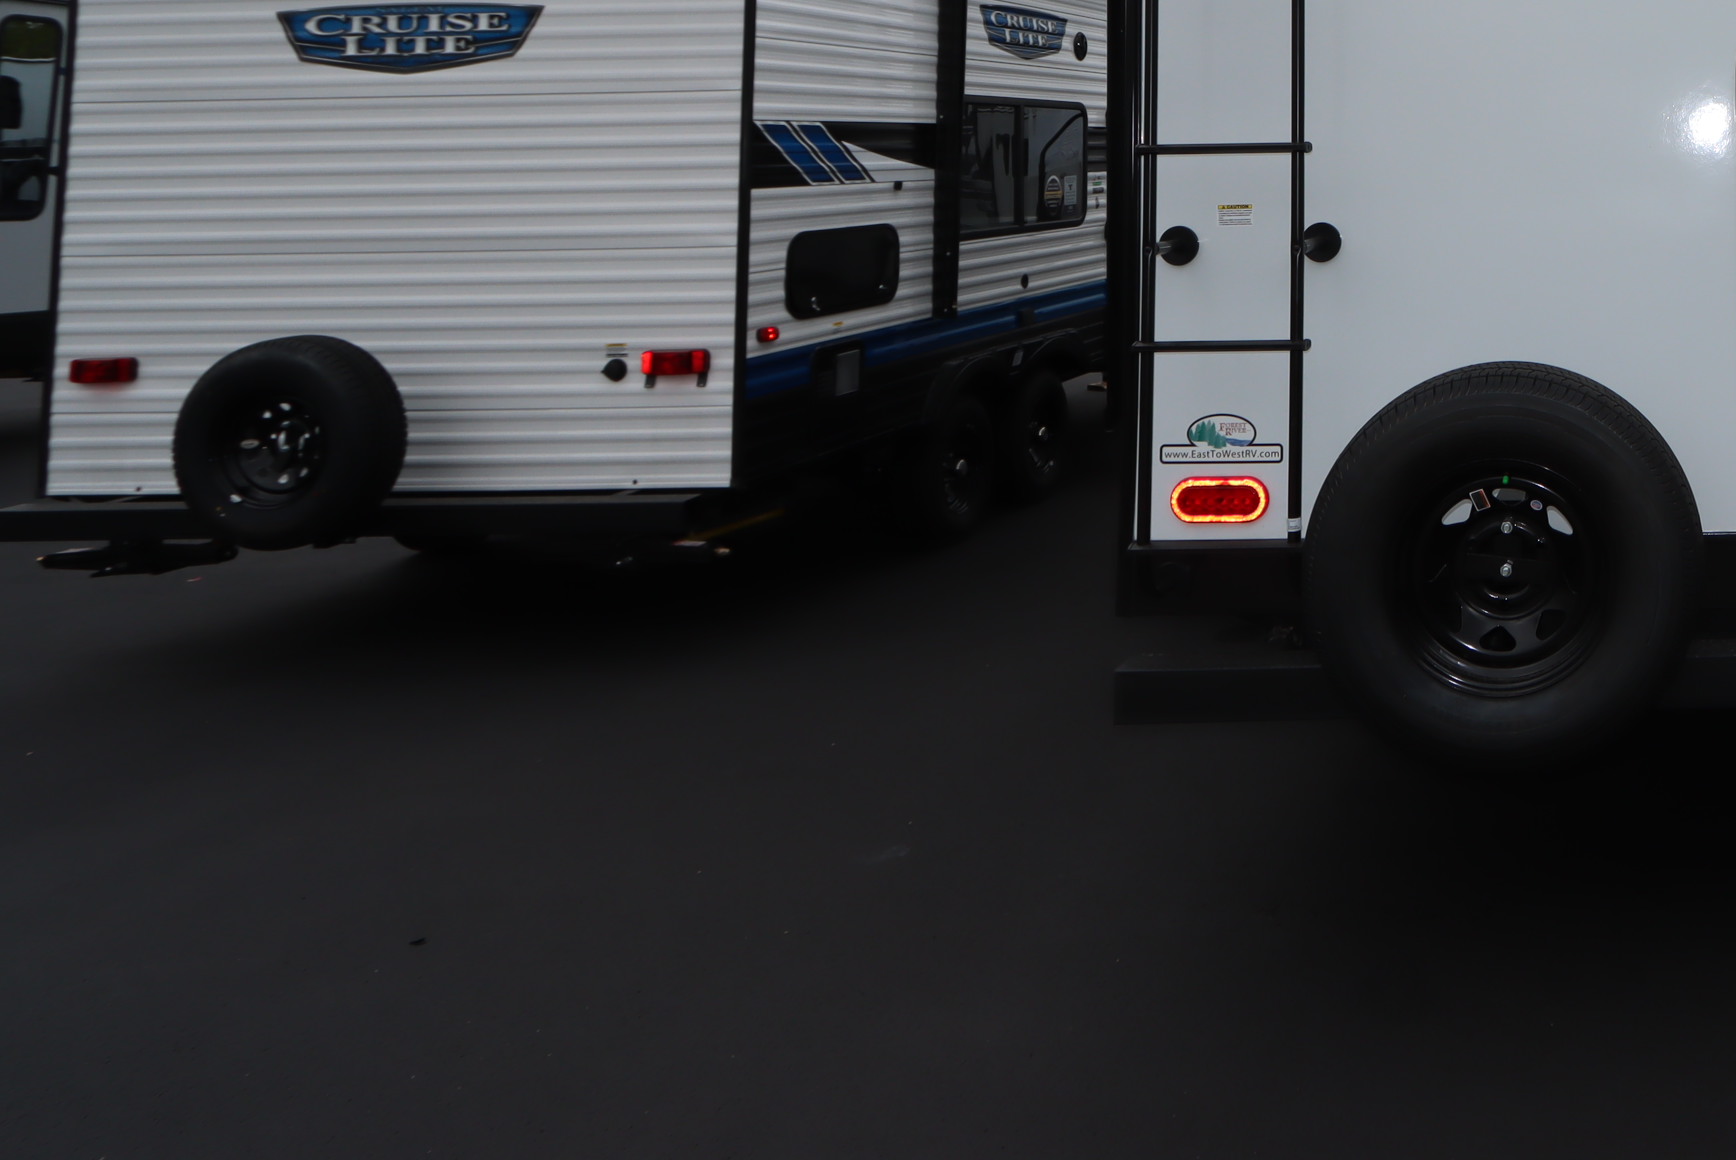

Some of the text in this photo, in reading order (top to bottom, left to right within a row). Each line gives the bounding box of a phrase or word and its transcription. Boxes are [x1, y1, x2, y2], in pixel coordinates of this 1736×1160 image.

[303, 12, 509, 36] CRUISE
[990, 10, 1059, 34] CRUISE
[341, 35, 477, 56] LITE
[1002, 28, 1050, 47] LITE
[1219, 422, 1247, 431] FOREST
[1225, 427, 1248, 436] RIVER
[1164, 449, 1280, 460] www.EastToWestRV.com
